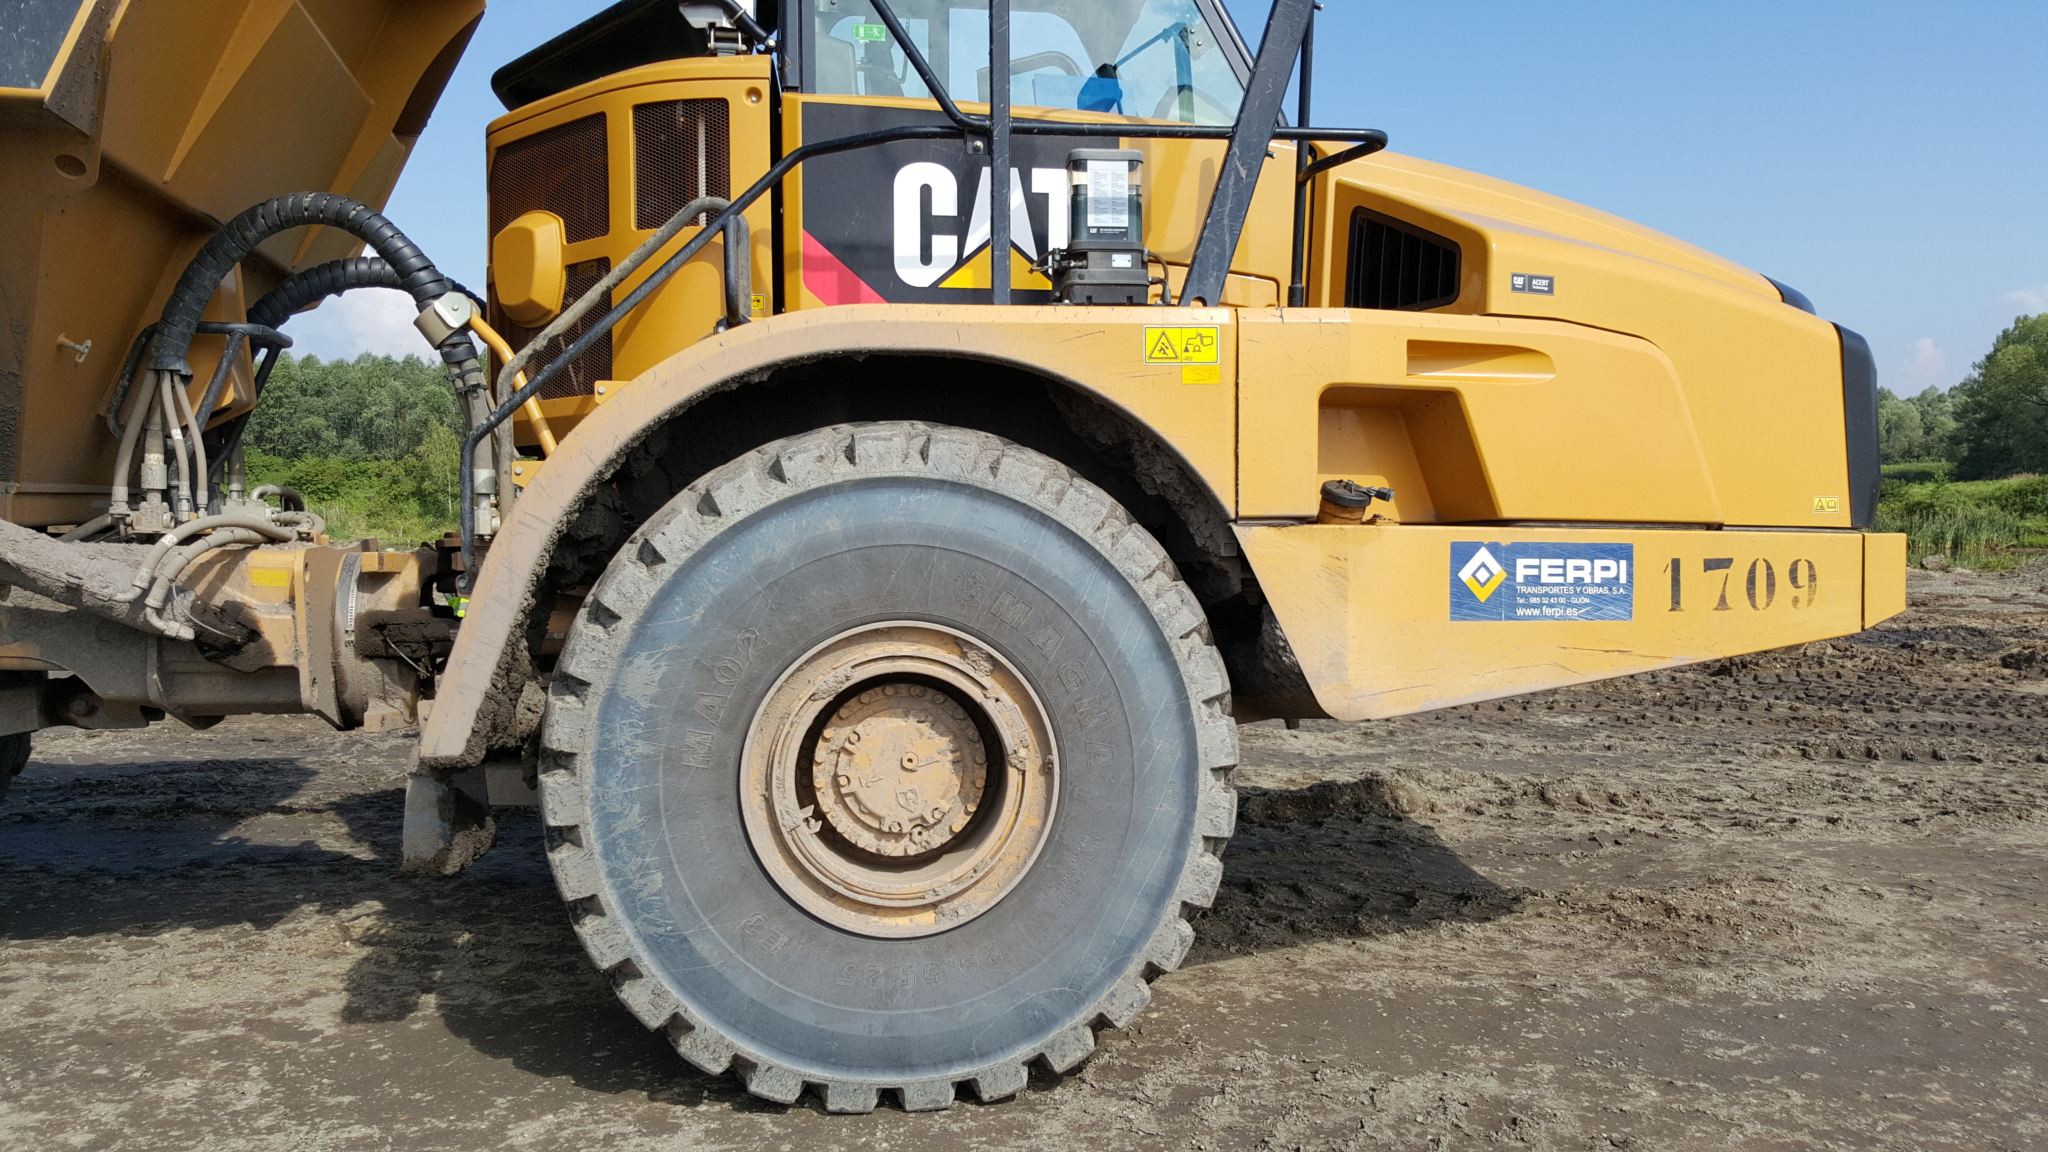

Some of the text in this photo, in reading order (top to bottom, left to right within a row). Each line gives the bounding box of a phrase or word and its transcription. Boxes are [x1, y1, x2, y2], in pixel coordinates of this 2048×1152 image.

[893, 162, 1067, 287] CAT
[1513, 276, 1524, 284] CAT
[1516, 559, 1626, 583] FERPI
[1516, 586, 1626, 595] TRANSPORTES Y OBRAS, S.A.
[1658, 557, 1817, 612] 1709
[1570, 596, 1590, 604] GIJÓN
[1516, 606, 1578, 618] www.ferpi.es
[989, 590, 1117, 773] MAGNA
